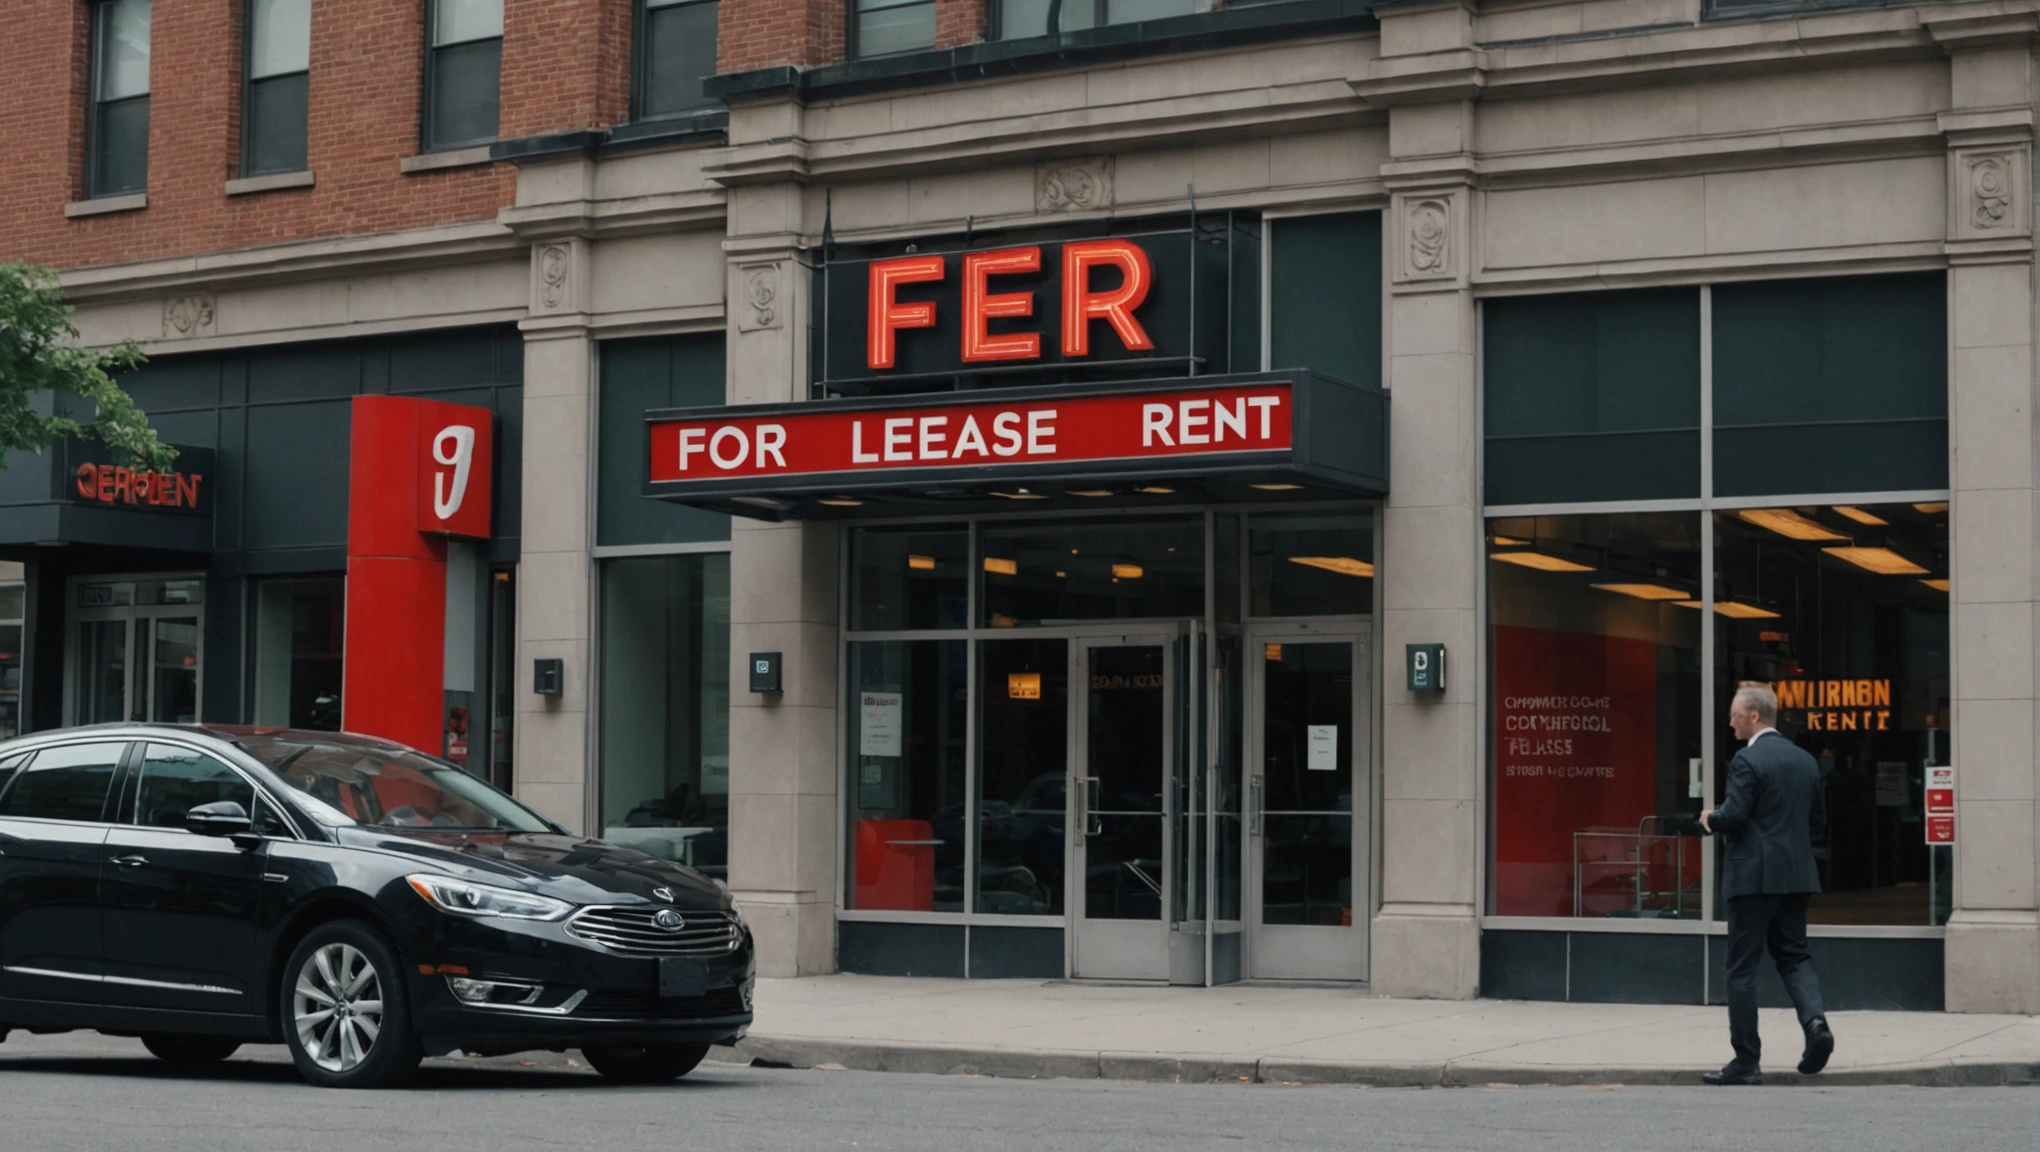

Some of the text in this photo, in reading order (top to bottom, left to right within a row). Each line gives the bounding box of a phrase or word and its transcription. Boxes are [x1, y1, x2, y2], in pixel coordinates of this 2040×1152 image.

[868, 238, 1154, 369] FER
[679, 396, 1280, 471] FOR LEEASE RENT
